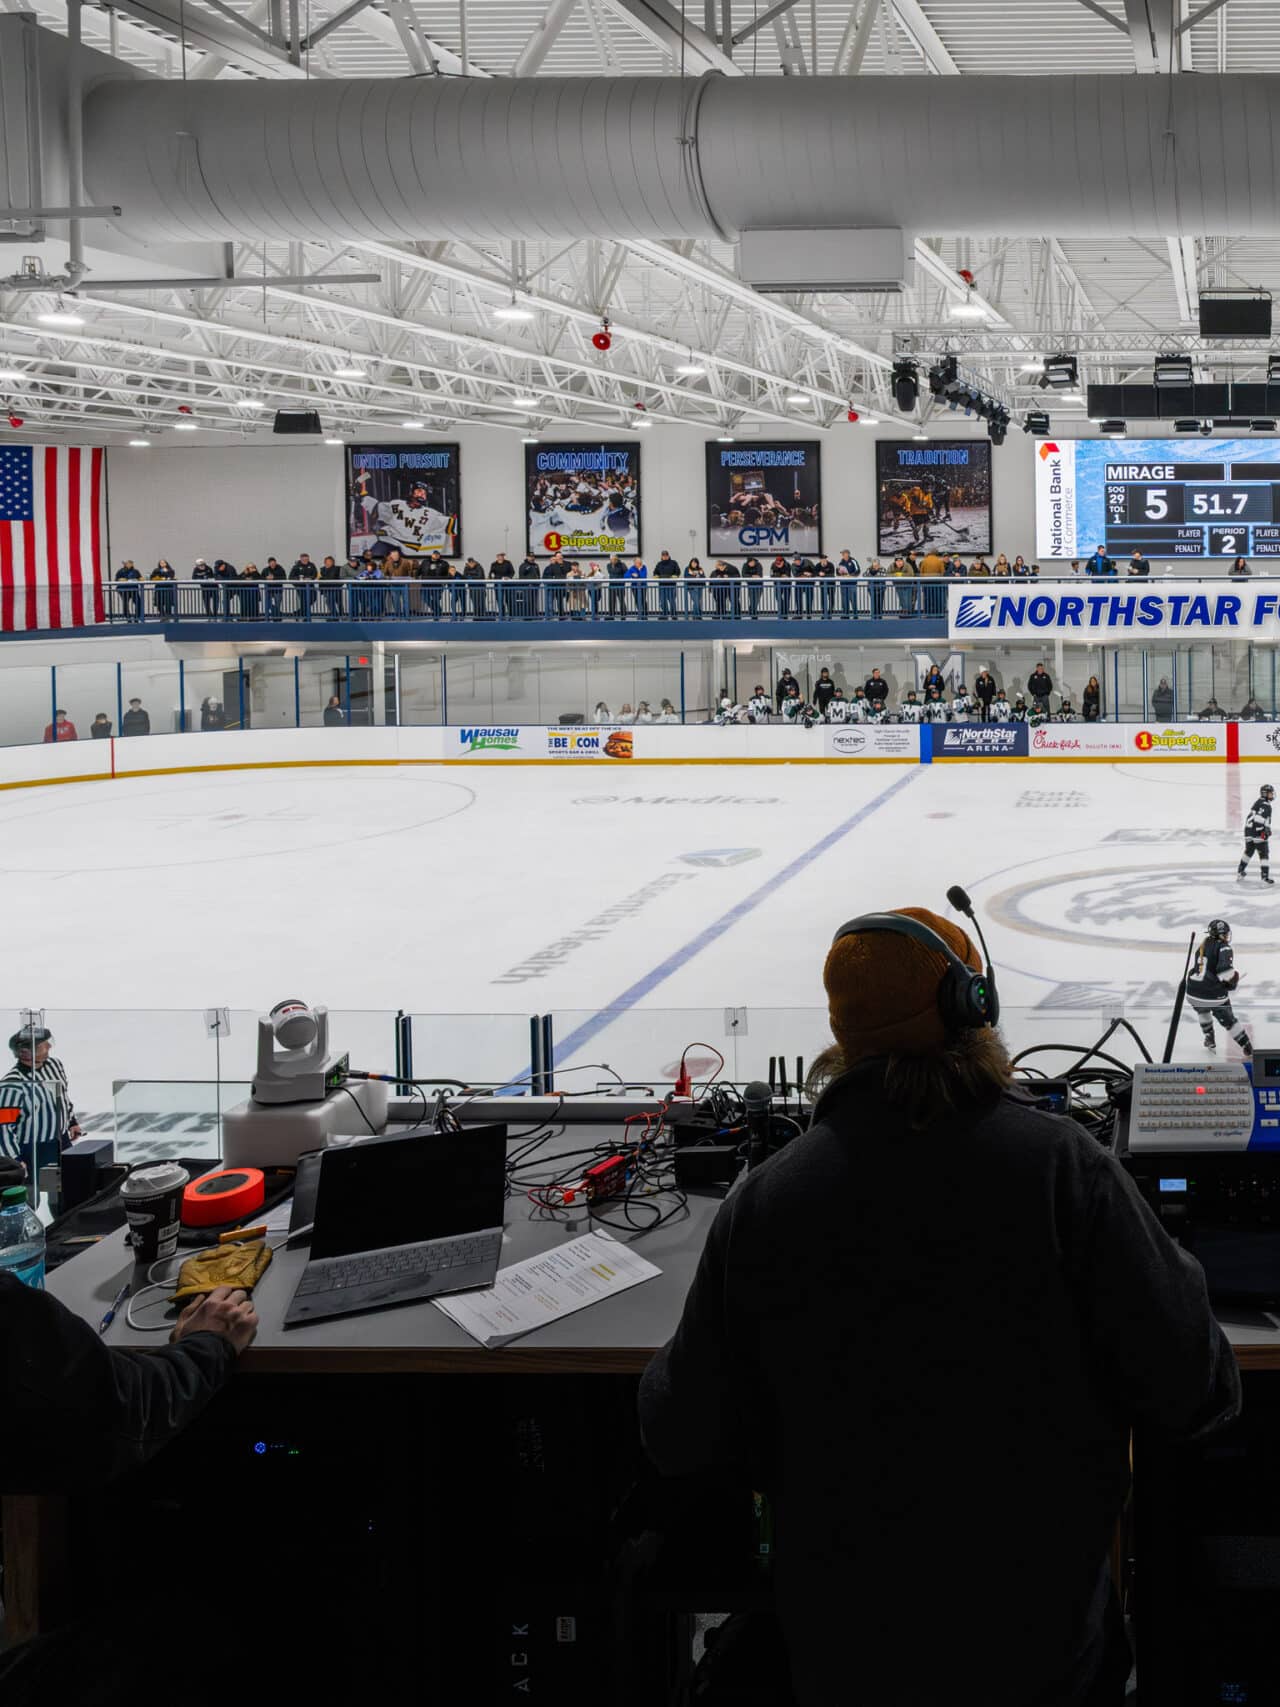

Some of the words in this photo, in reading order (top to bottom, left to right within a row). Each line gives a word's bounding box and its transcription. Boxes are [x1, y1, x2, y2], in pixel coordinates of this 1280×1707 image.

[353, 453, 397, 469] UNITED
[399, 452, 449, 468] PURSUIT
[537, 453, 628, 470] COMMUNITY
[721, 451, 805, 466] PERSEVERANCE
[897, 449, 968, 465] TRADITION
[1050, 459, 1061, 494] Bank
[1107, 466, 1175, 480] MIRAGE
[1109, 494, 1125, 504] 29
[1145, 489, 1168, 520] 5
[1192, 494, 1249, 514] 51.7
[1113, 514, 1121, 524] 1
[1050, 498, 1062, 556] National
[1178, 530, 1201, 538] PLAYER
[1256, 529, 1279, 537] PLAYER
[549, 534, 558, 549] 1
[560, 534, 625, 547] SuperOne
[738, 527, 789, 546] GPM
[1175, 545, 1201, 553] PENALTY
[1221, 535, 1236, 554] 2
[997, 595, 1241, 627] NORTHSTAR
[832, 708, 843, 718] M
[904, 711, 915, 720] M
[932, 709, 942, 718] M
[460, 728, 519, 744] Wausau
[962, 728, 1017, 739] NorthStar
[1140, 733, 1149, 748] 1
[1151, 735, 1216, 748] SuperOne
[471, 735, 518, 750] Homes
